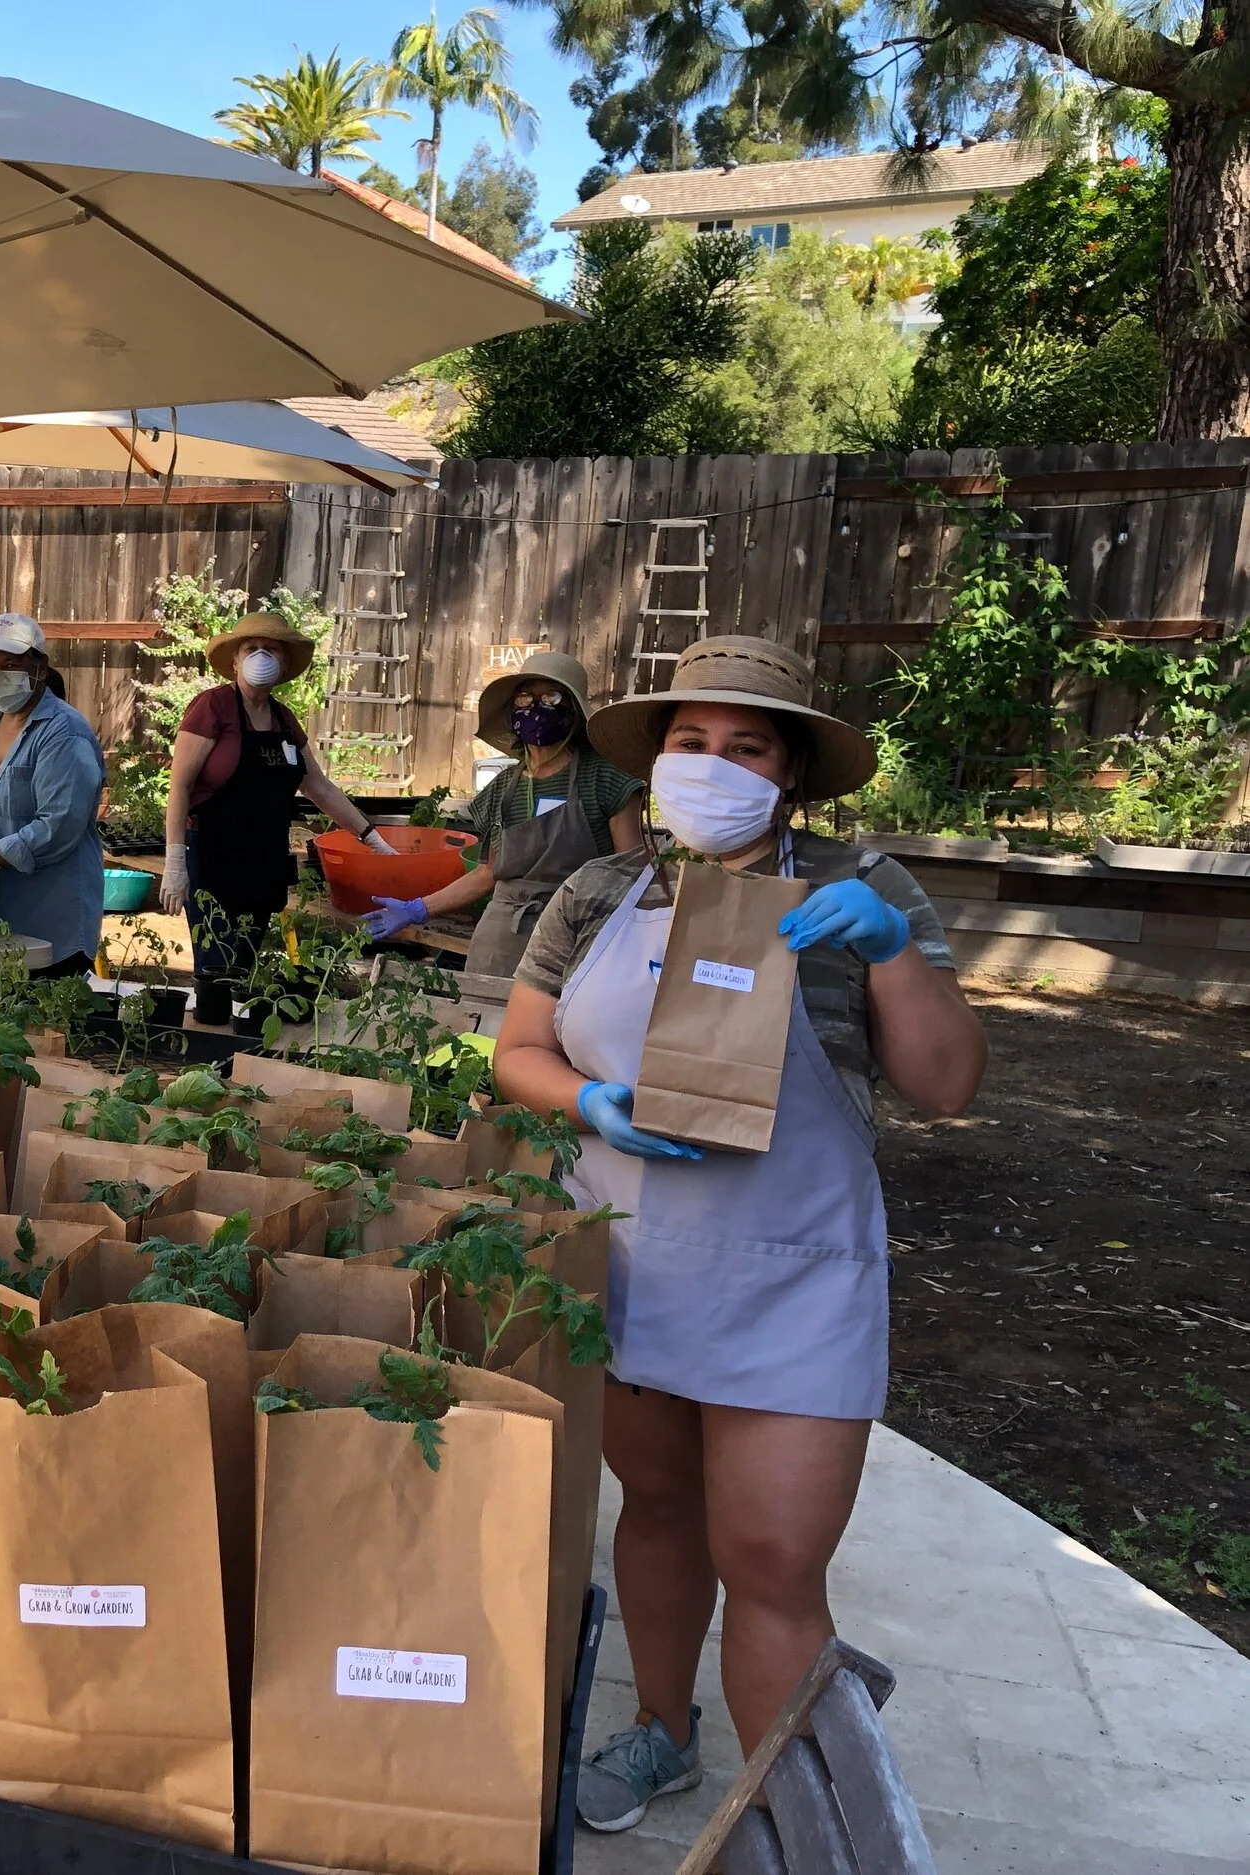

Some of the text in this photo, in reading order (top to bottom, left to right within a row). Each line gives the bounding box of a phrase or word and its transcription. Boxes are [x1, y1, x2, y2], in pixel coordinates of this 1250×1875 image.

[28, 1599, 134, 1615] GRAB & GROW GARDENS
[348, 1664, 457, 1688] GRAB & GROW GARDENS
